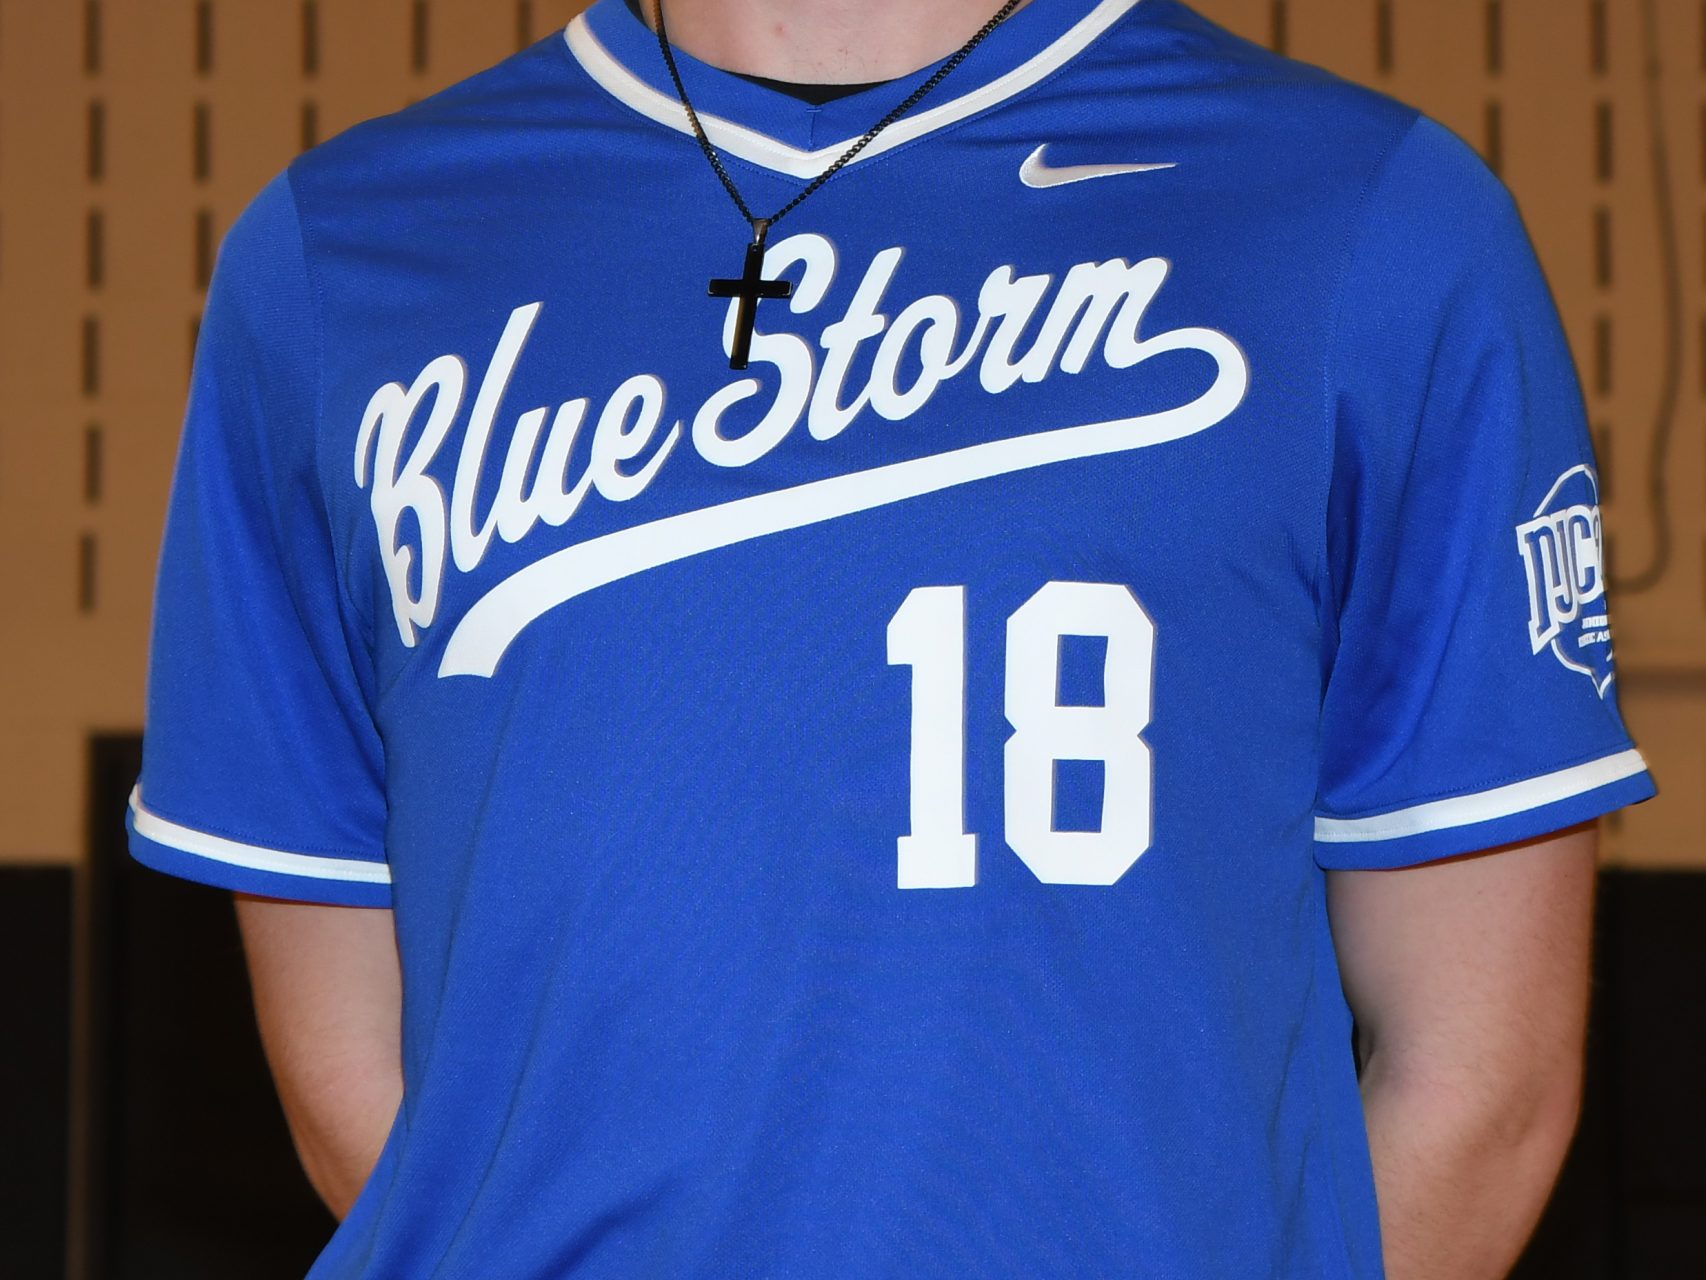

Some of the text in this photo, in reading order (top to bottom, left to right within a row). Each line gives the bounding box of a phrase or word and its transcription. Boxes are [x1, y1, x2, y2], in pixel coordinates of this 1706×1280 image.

[354, 233, 1180, 648] Blue Storm
[886, 581, 1156, 890] 18
